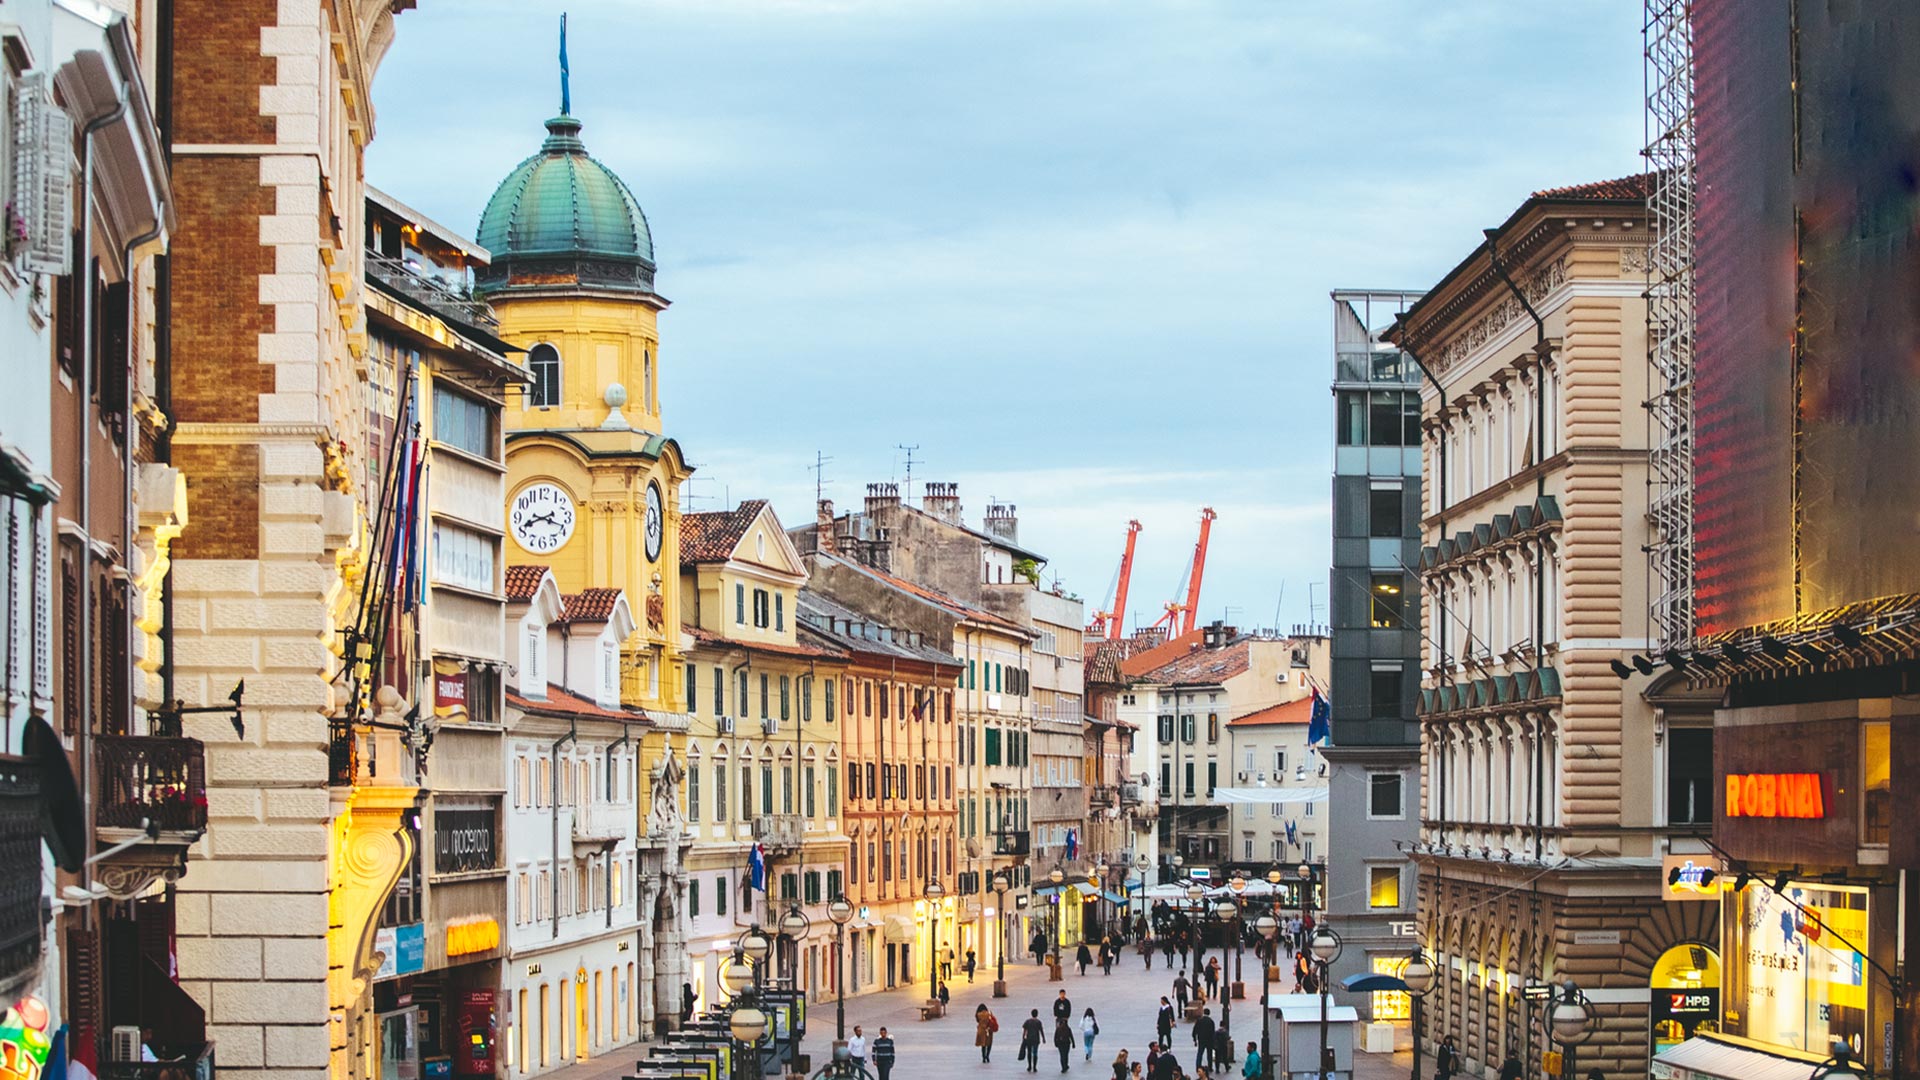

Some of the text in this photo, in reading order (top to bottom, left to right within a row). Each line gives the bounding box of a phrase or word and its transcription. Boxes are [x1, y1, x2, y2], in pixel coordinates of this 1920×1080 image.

[529, 490, 536, 503] 11
[539, 488, 550, 500] 12
[553, 491, 558, 504] 1
[518, 497, 529, 510] 10
[559, 497, 566, 511] 2
[513, 511, 522, 524] 9
[563, 511, 572, 524] 3
[518, 526, 527, 538] 8
[558, 525, 566, 536] 4
[528, 534, 536, 547] 7
[538, 536, 547, 549] 6
[550, 534, 558, 547] 5
[1685, 995, 1710, 1007] HPB
